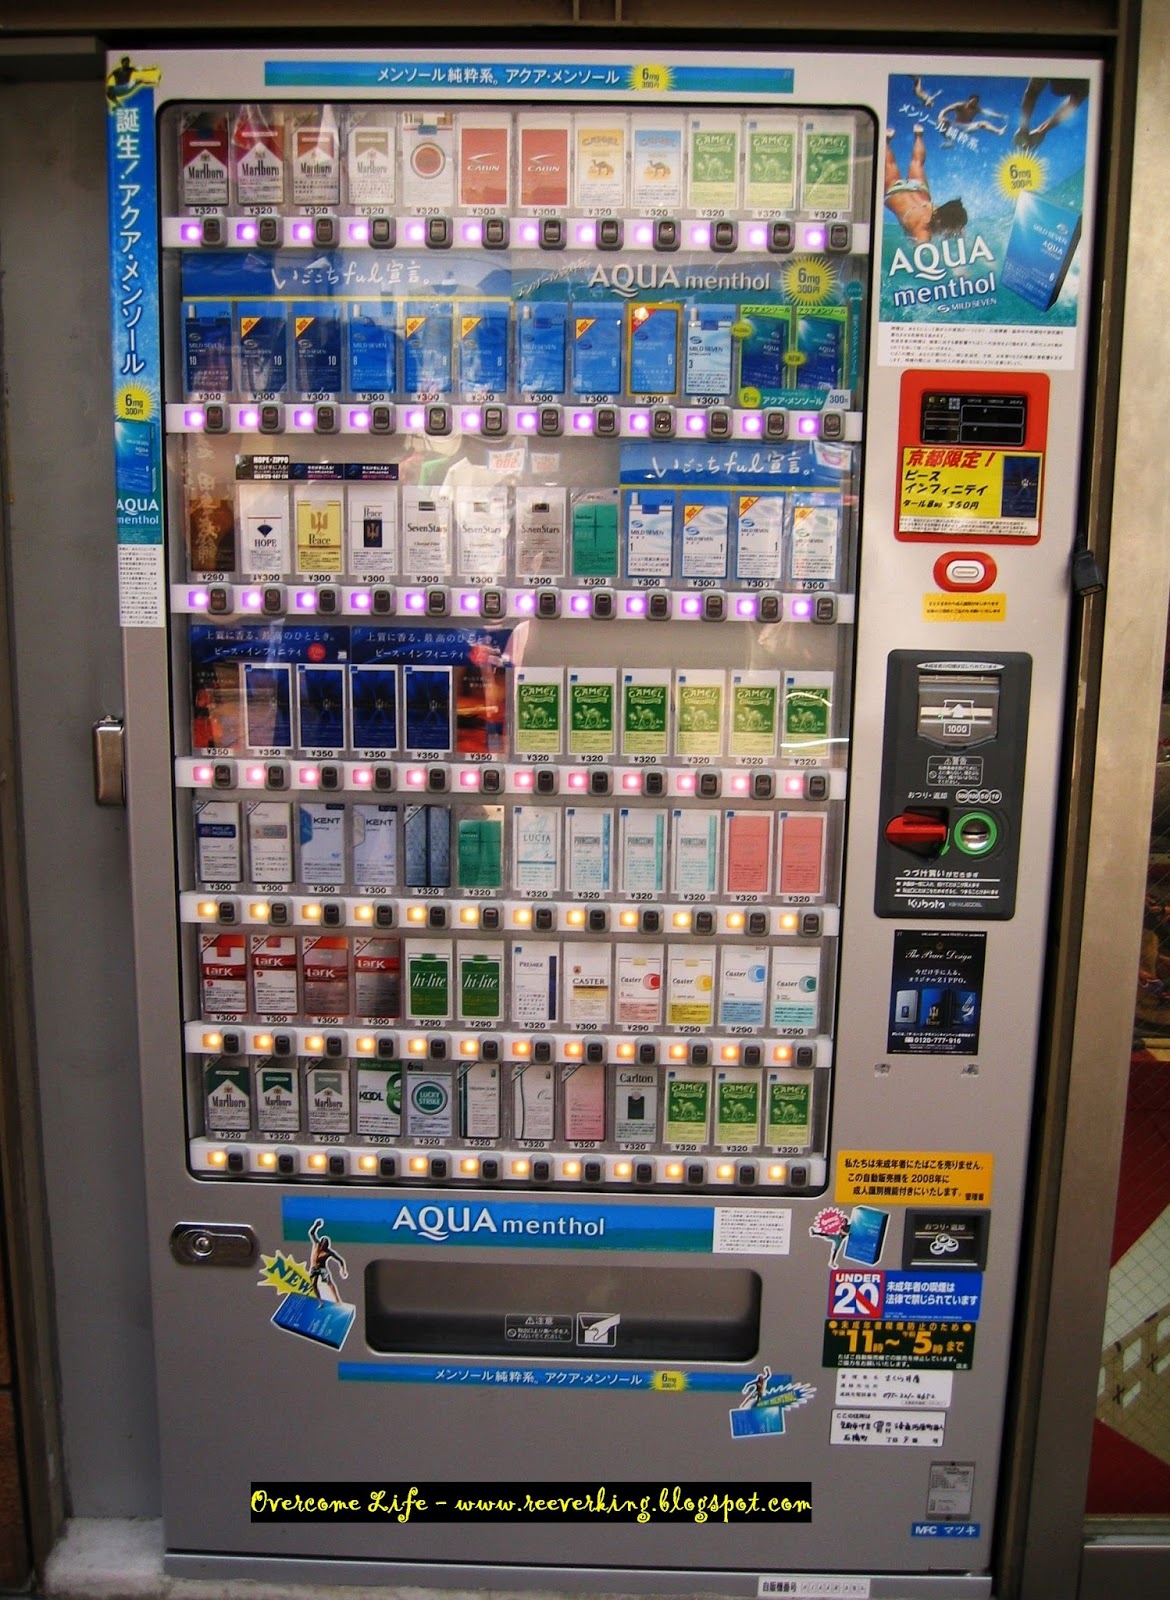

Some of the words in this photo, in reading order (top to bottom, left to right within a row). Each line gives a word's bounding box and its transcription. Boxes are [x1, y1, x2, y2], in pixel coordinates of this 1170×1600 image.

[188, 163, 224, 179] Marlboro
[241, 160, 279, 179] Marlboro
[300, 162, 332, 174] Marlboro
[357, 162, 387, 174] Marlboro
[194, 207, 219, 215] ¥320
[361, 207, 385, 215] ¥320
[472, 207, 496, 215] ¥300
[645, 208, 669, 217] ¥320
[757, 210, 782, 218] ¥320
[889, 234, 995, 281] AQUA
[588, 263, 680, 298] AQUA
[684, 272, 770, 291] menthol
[894, 272, 996, 307] menthol
[125, 393, 143, 409] 6mg
[252, 393, 276, 401] ¥300
[361, 393, 385, 401] ¥300
[641, 395, 665, 404] ¥300
[116, 498, 159, 516] AQUA
[116, 515, 159, 526] menthol
[254, 538, 277, 548] HOPE
[258, 573, 281, 582] ¥300
[362, 574, 386, 583] ¥300
[584, 577, 607, 586] ¥320
[692, 579, 716, 588] ¥300
[947, 724, 967, 734] 1000
[364, 750, 387, 759] ¥350
[527, 754, 550, 762] ¥320
[633, 756, 657, 764] ¥320
[794, 758, 818, 766] ¥320
[313, 816, 341, 826] KENT
[366, 818, 393, 827] KENT
[313, 885, 336, 893] ¥300
[417, 887, 440, 895] ¥320
[578, 891, 601, 899] ¥320
[683, 893, 707, 901] ¥320
[907, 898, 946, 909] Kubota
[412, 972, 446, 989] hi-lite
[463, 974, 498, 990] hi-lite
[572, 977, 605, 985] CASTER
[216, 1014, 238, 1022] ¥300
[317, 1016, 339, 1024] ¥300
[470, 1020, 493, 1028] ¥290
[627, 1024, 650, 1032] ¥290
[731, 1026, 754, 1034] ¥290
[619, 1072, 654, 1084] Carlton
[358, 1090, 384, 1101] KOOL
[212, 1095, 247, 1108] Marlboro
[265, 1095, 292, 1107] Marlboro
[314, 1097, 343, 1108] Marlboro
[269, 1133, 292, 1141] ¥320
[369, 1136, 391, 1144] ¥320
[523, 1141, 546, 1149] ¥320
[777, 1146, 800, 1154] ¥320
[392, 1205, 498, 1241] AQUA
[502, 1217, 605, 1236] menthol
[835, 1273, 881, 1283] UNDER
[833, 1282, 879, 1315] 20
